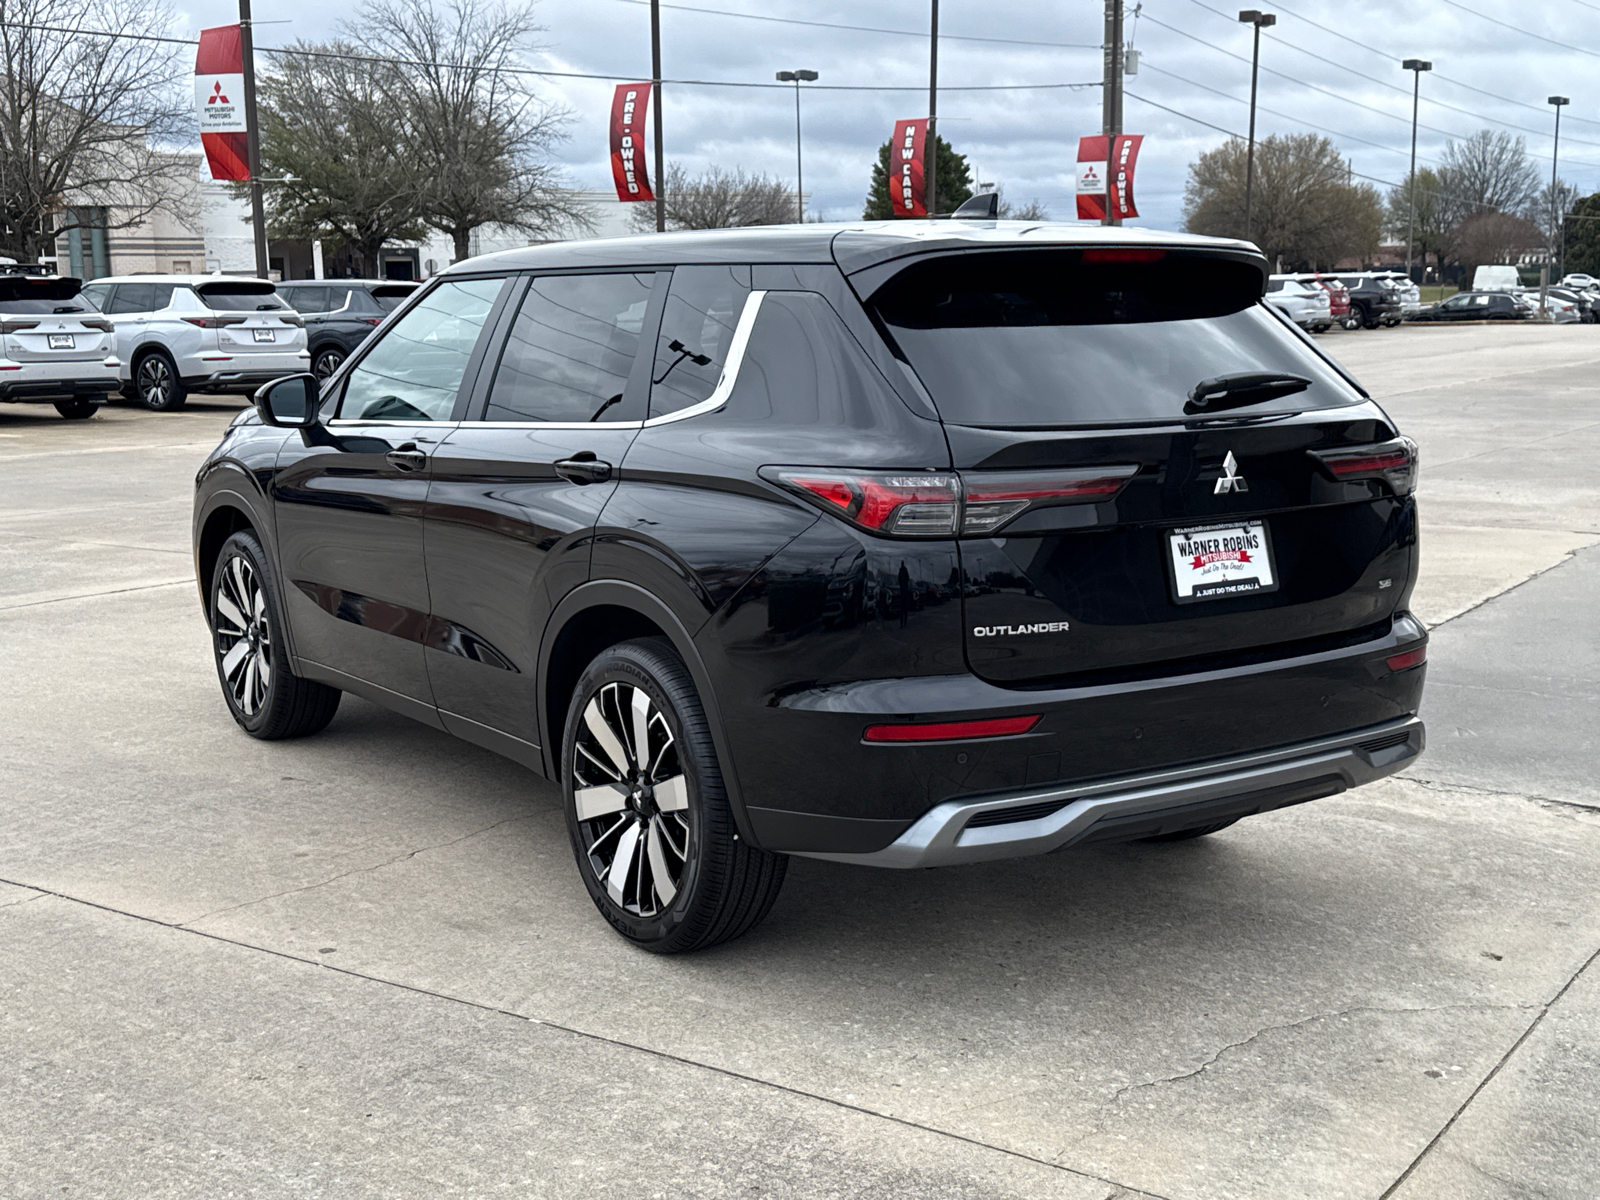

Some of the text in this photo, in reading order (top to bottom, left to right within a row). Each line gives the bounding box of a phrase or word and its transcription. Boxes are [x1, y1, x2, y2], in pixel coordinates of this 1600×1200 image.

[902, 126, 916, 209] NEW CARS
[1178, 534, 1259, 557] WARNER ROBINS
[1200, 551, 1241, 564] MITSUBISHI
[1201, 566, 1212, 576] Just
[1237, 582, 1254, 590] DEAL!
[973, 622, 1069, 636] OUTLANDER
[596, 896, 636, 936] NEXEN
